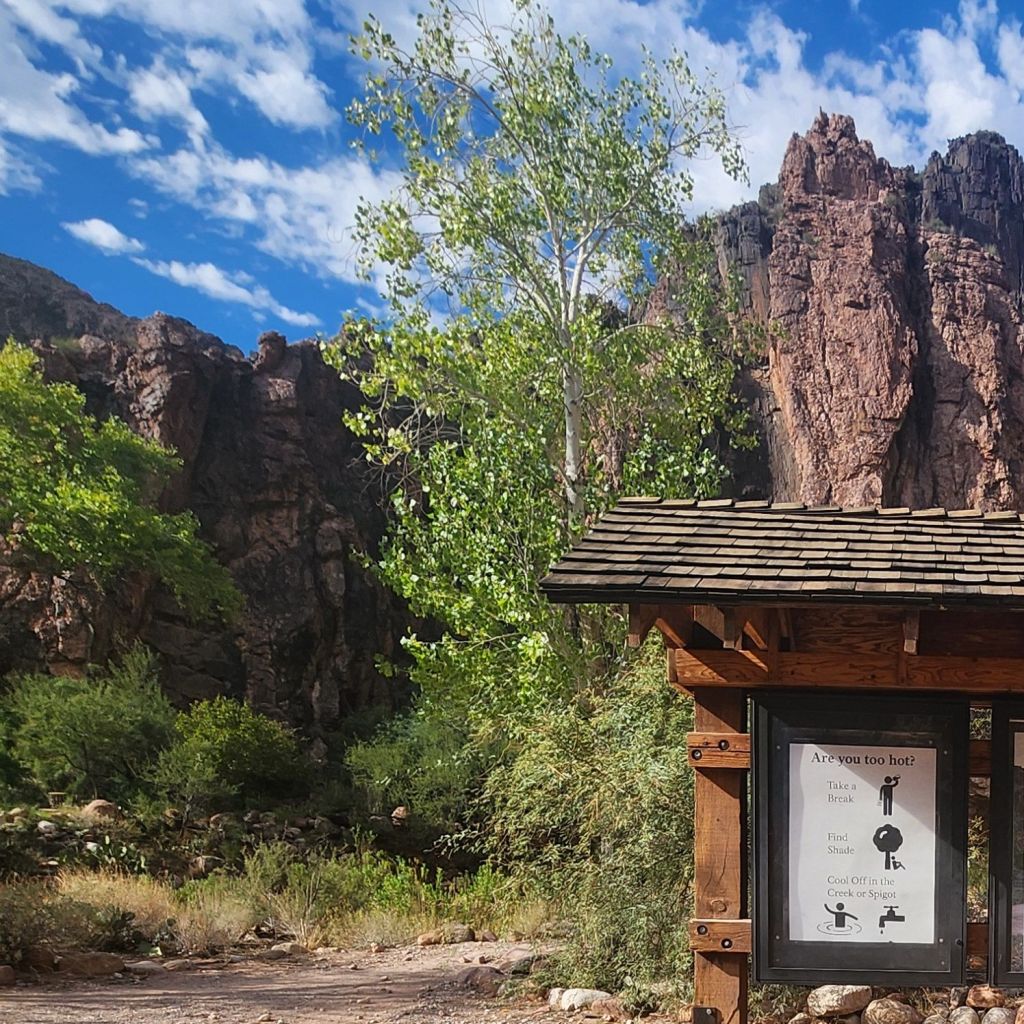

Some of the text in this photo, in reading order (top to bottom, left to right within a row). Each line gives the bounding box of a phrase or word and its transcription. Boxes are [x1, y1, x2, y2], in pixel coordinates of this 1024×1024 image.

[811, 753, 915, 766] Are you too hot?
[827, 781, 849, 790] Take
[828, 794, 854, 803] Break
[828, 833, 848, 842] Find
[828, 846, 854, 855] Shade
[827, 876, 894, 886] Cool Off in the
[827, 889, 854, 897] Creek
[869, 890, 896, 900] Spigot
